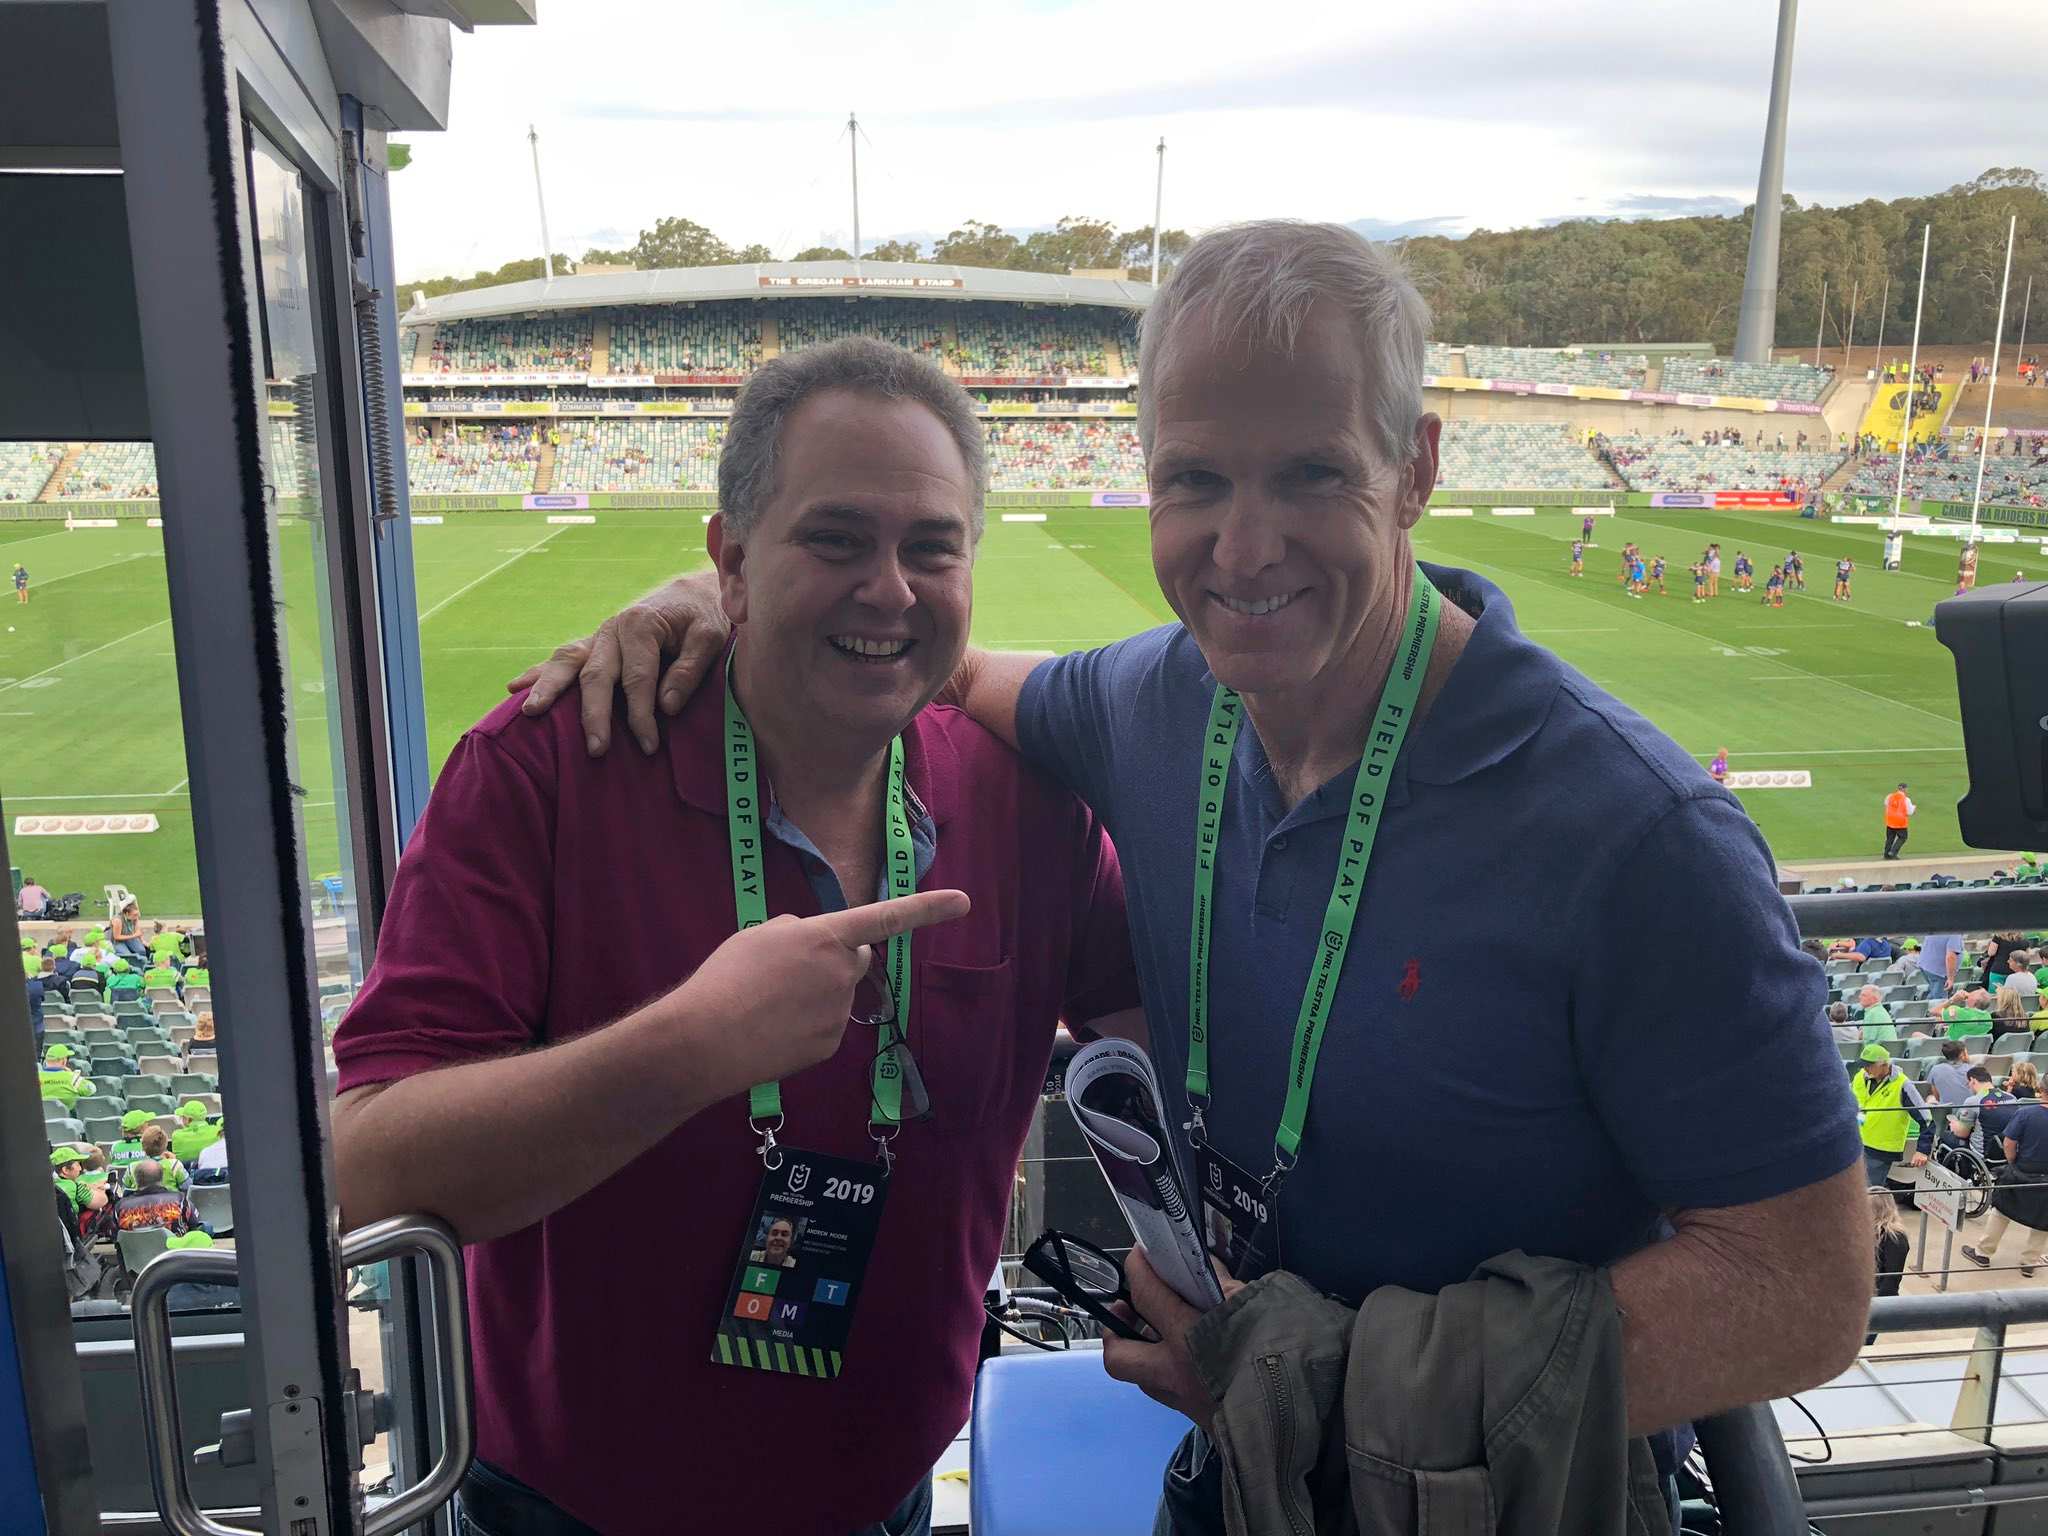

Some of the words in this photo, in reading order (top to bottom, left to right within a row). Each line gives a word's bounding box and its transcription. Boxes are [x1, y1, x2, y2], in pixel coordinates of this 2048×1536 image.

[768, 277, 792, 286] THE
[858, 277, 914, 286] LARKHAM
[918, 279, 955, 287] STAND
[1942, 504, 1992, 520] CANBERA
[1993, 507, 2035, 524] RAIDERS
[1402, 615, 1428, 681] PREMIERSHIP
[1213, 687, 1240, 745] PLAY
[733, 720, 750, 783] FIELD
[1367, 703, 1404, 777] FIELD
[892, 755, 903, 805] PLAY
[1208, 758, 1223, 787] OF
[736, 797, 752, 825] OF
[892, 814, 905, 838] OF
[1356, 792, 1375, 825] OF
[1200, 800, 1217, 870] FIELD
[739, 838, 758, 895] PLAY
[895, 850, 909, 898] IELD
[1338, 838, 1364, 906] PLAY
[1197, 894, 1207, 960] PREMIERSHIP
[894, 935, 904, 998] PREMIERSHIP
[1322, 950, 1334, 970] NRL
[1309, 972, 1329, 1018] TELSTRA
[1296, 1020, 1316, 1089] PREMIERSHIP
[769, 1193, 814, 1207] PREMIERSHIP
[822, 1177, 875, 1205] 2019
[1924, 1168, 1940, 1188] Bay
[1233, 1185, 1268, 1224] 2019
[806, 1228, 828, 1237] ANDREW
[829, 1232, 848, 1241] MOORE
[755, 1272, 768, 1288] F
[827, 1284, 839, 1300] T
[747, 1299, 760, 1314] O
[780, 1304, 798, 1320] M
[772, 1329, 794, 1338] MEDIA
